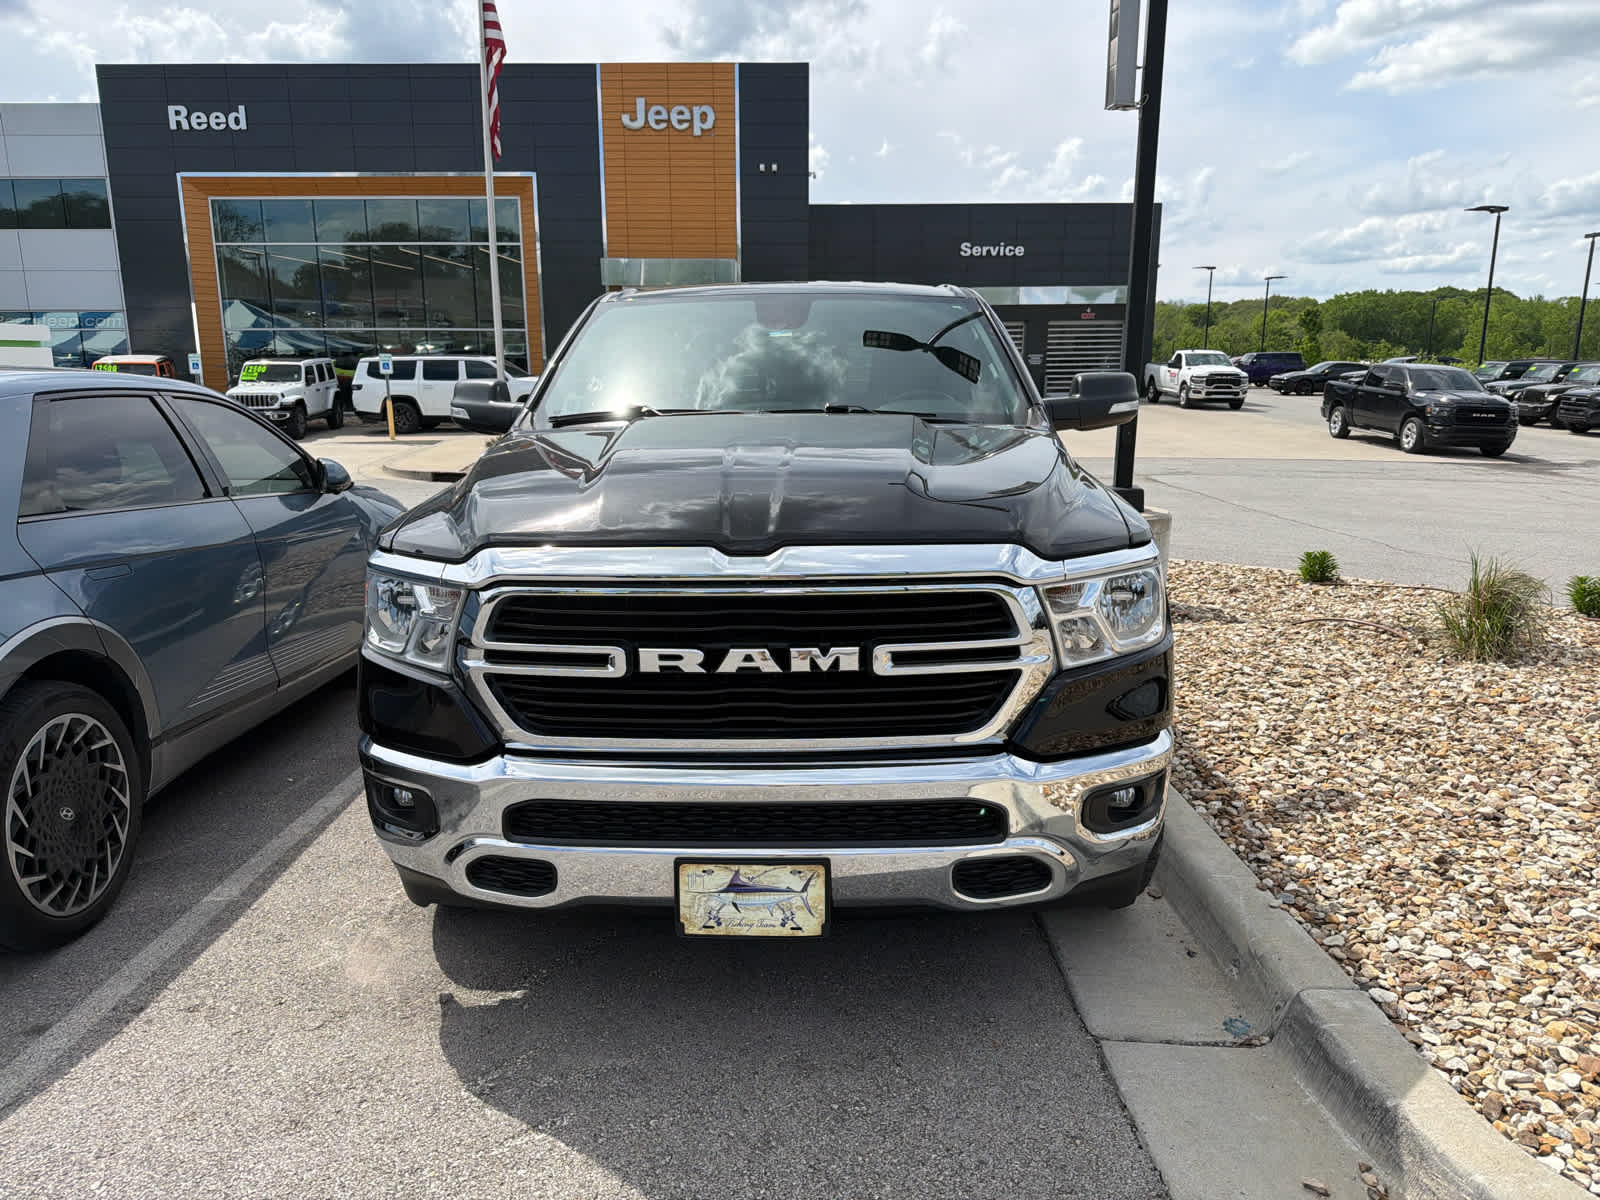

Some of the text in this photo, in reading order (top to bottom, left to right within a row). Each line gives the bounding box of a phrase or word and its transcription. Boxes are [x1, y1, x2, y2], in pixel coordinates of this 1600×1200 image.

[167, 104, 248, 131] Reed
[621, 96, 716, 137] Jeep
[960, 242, 1025, 257] Service
[638, 647, 860, 673] RAM
